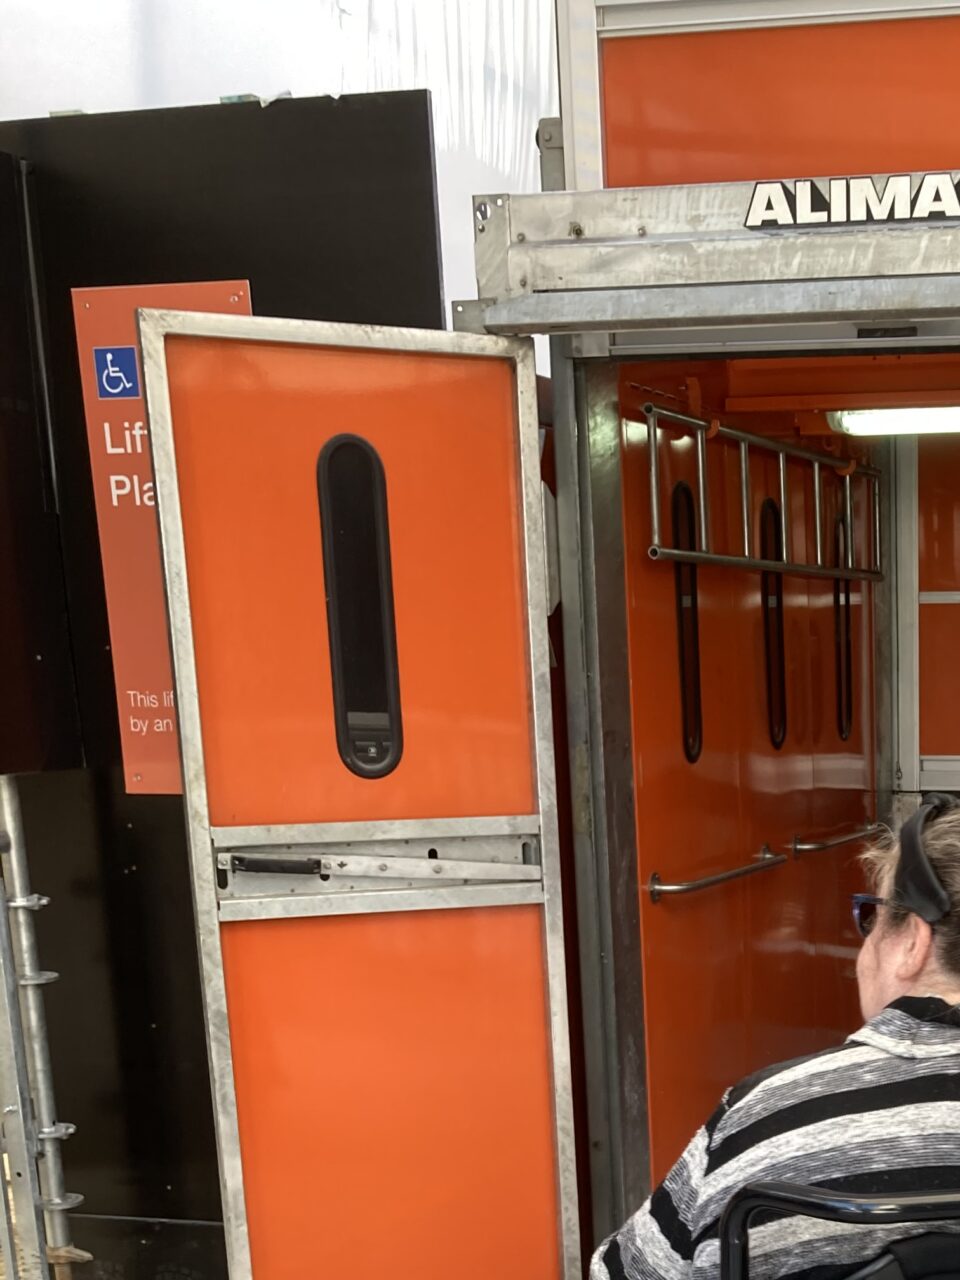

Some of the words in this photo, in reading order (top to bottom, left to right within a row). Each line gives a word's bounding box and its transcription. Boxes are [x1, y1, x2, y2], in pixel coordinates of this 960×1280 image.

[103, 421, 148, 454] Lif
[126, 690, 159, 708] This
[129, 715, 149, 736] by
[154, 718, 173, 732] an
